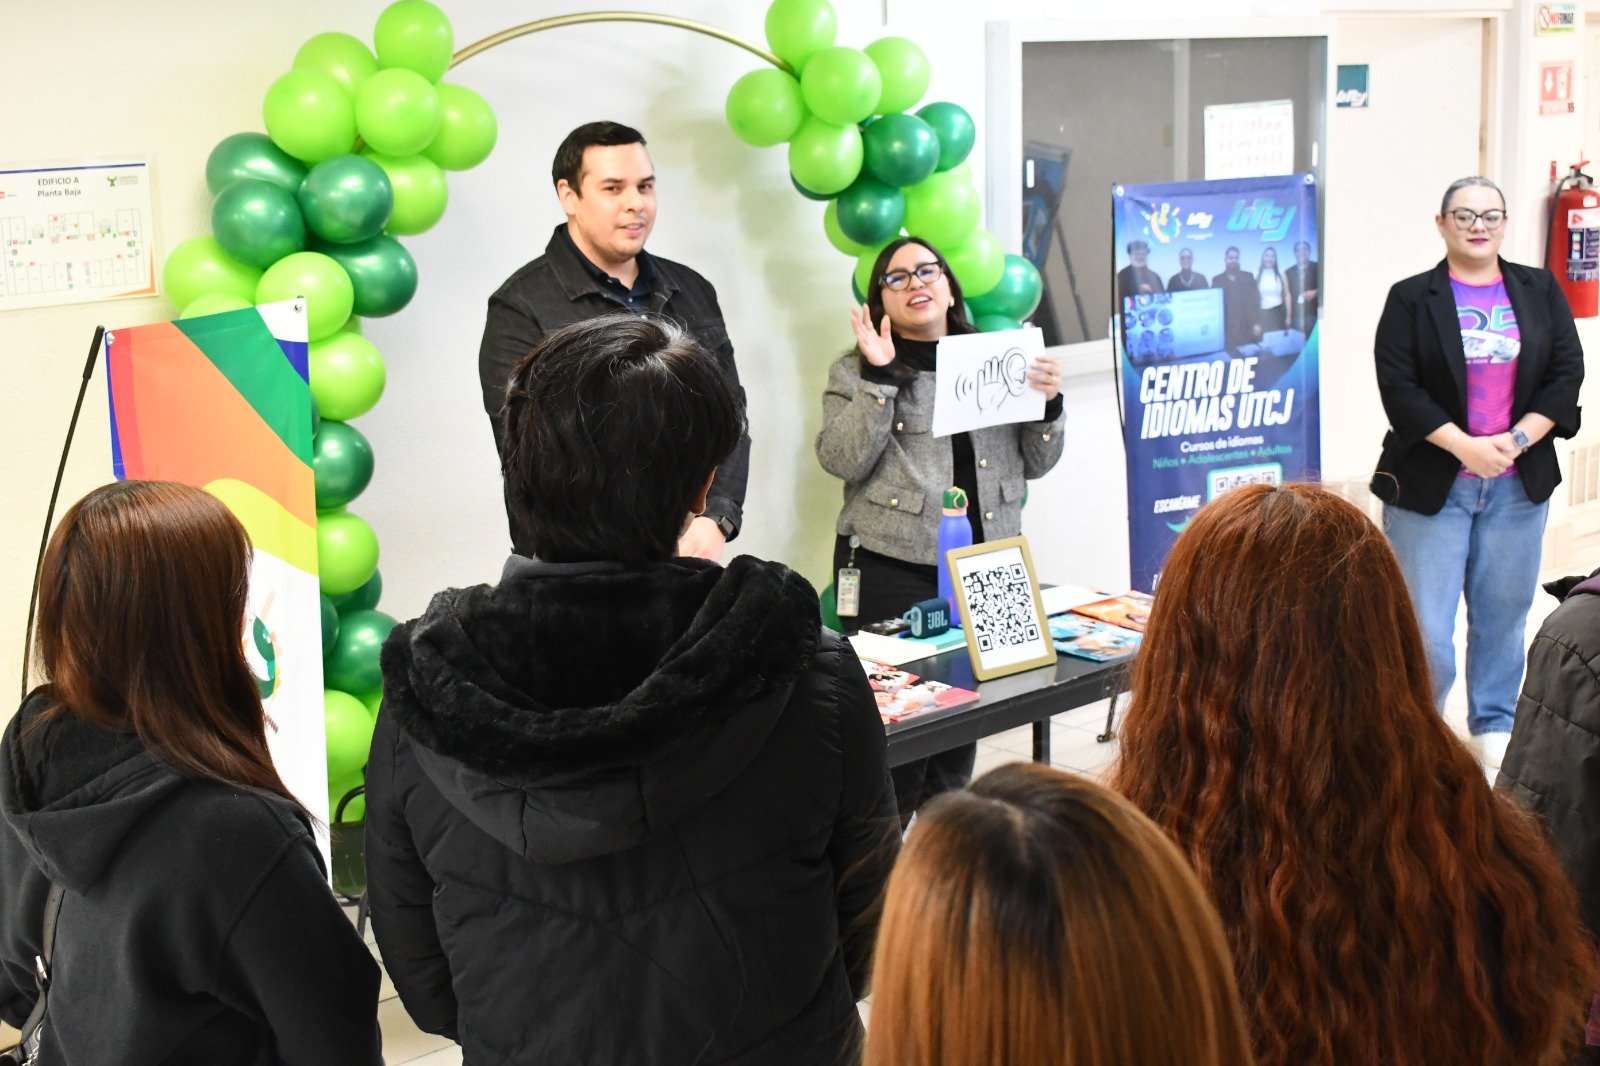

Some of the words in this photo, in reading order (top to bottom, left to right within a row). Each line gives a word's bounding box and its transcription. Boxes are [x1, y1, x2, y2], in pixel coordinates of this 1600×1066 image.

[37, 177, 72, 186] EDIFICIO
[73, 176, 80, 184] A
[37, 189, 63, 197] Planta
[64, 188, 82, 197] Baja
[1140, 360, 1225, 404] CENTRO
[1226, 356, 1259, 395] DE
[1140, 394, 1236, 440] IDIOMAS
[1237, 388, 1295, 429] UTCJ
[1180, 440, 1215, 453] Cursos
[1215, 437, 1228, 449] de
[1228, 435, 1264, 447] idiomas
[1256, 444, 1293, 456] Adultos
[927, 610, 948, 630] JBL
